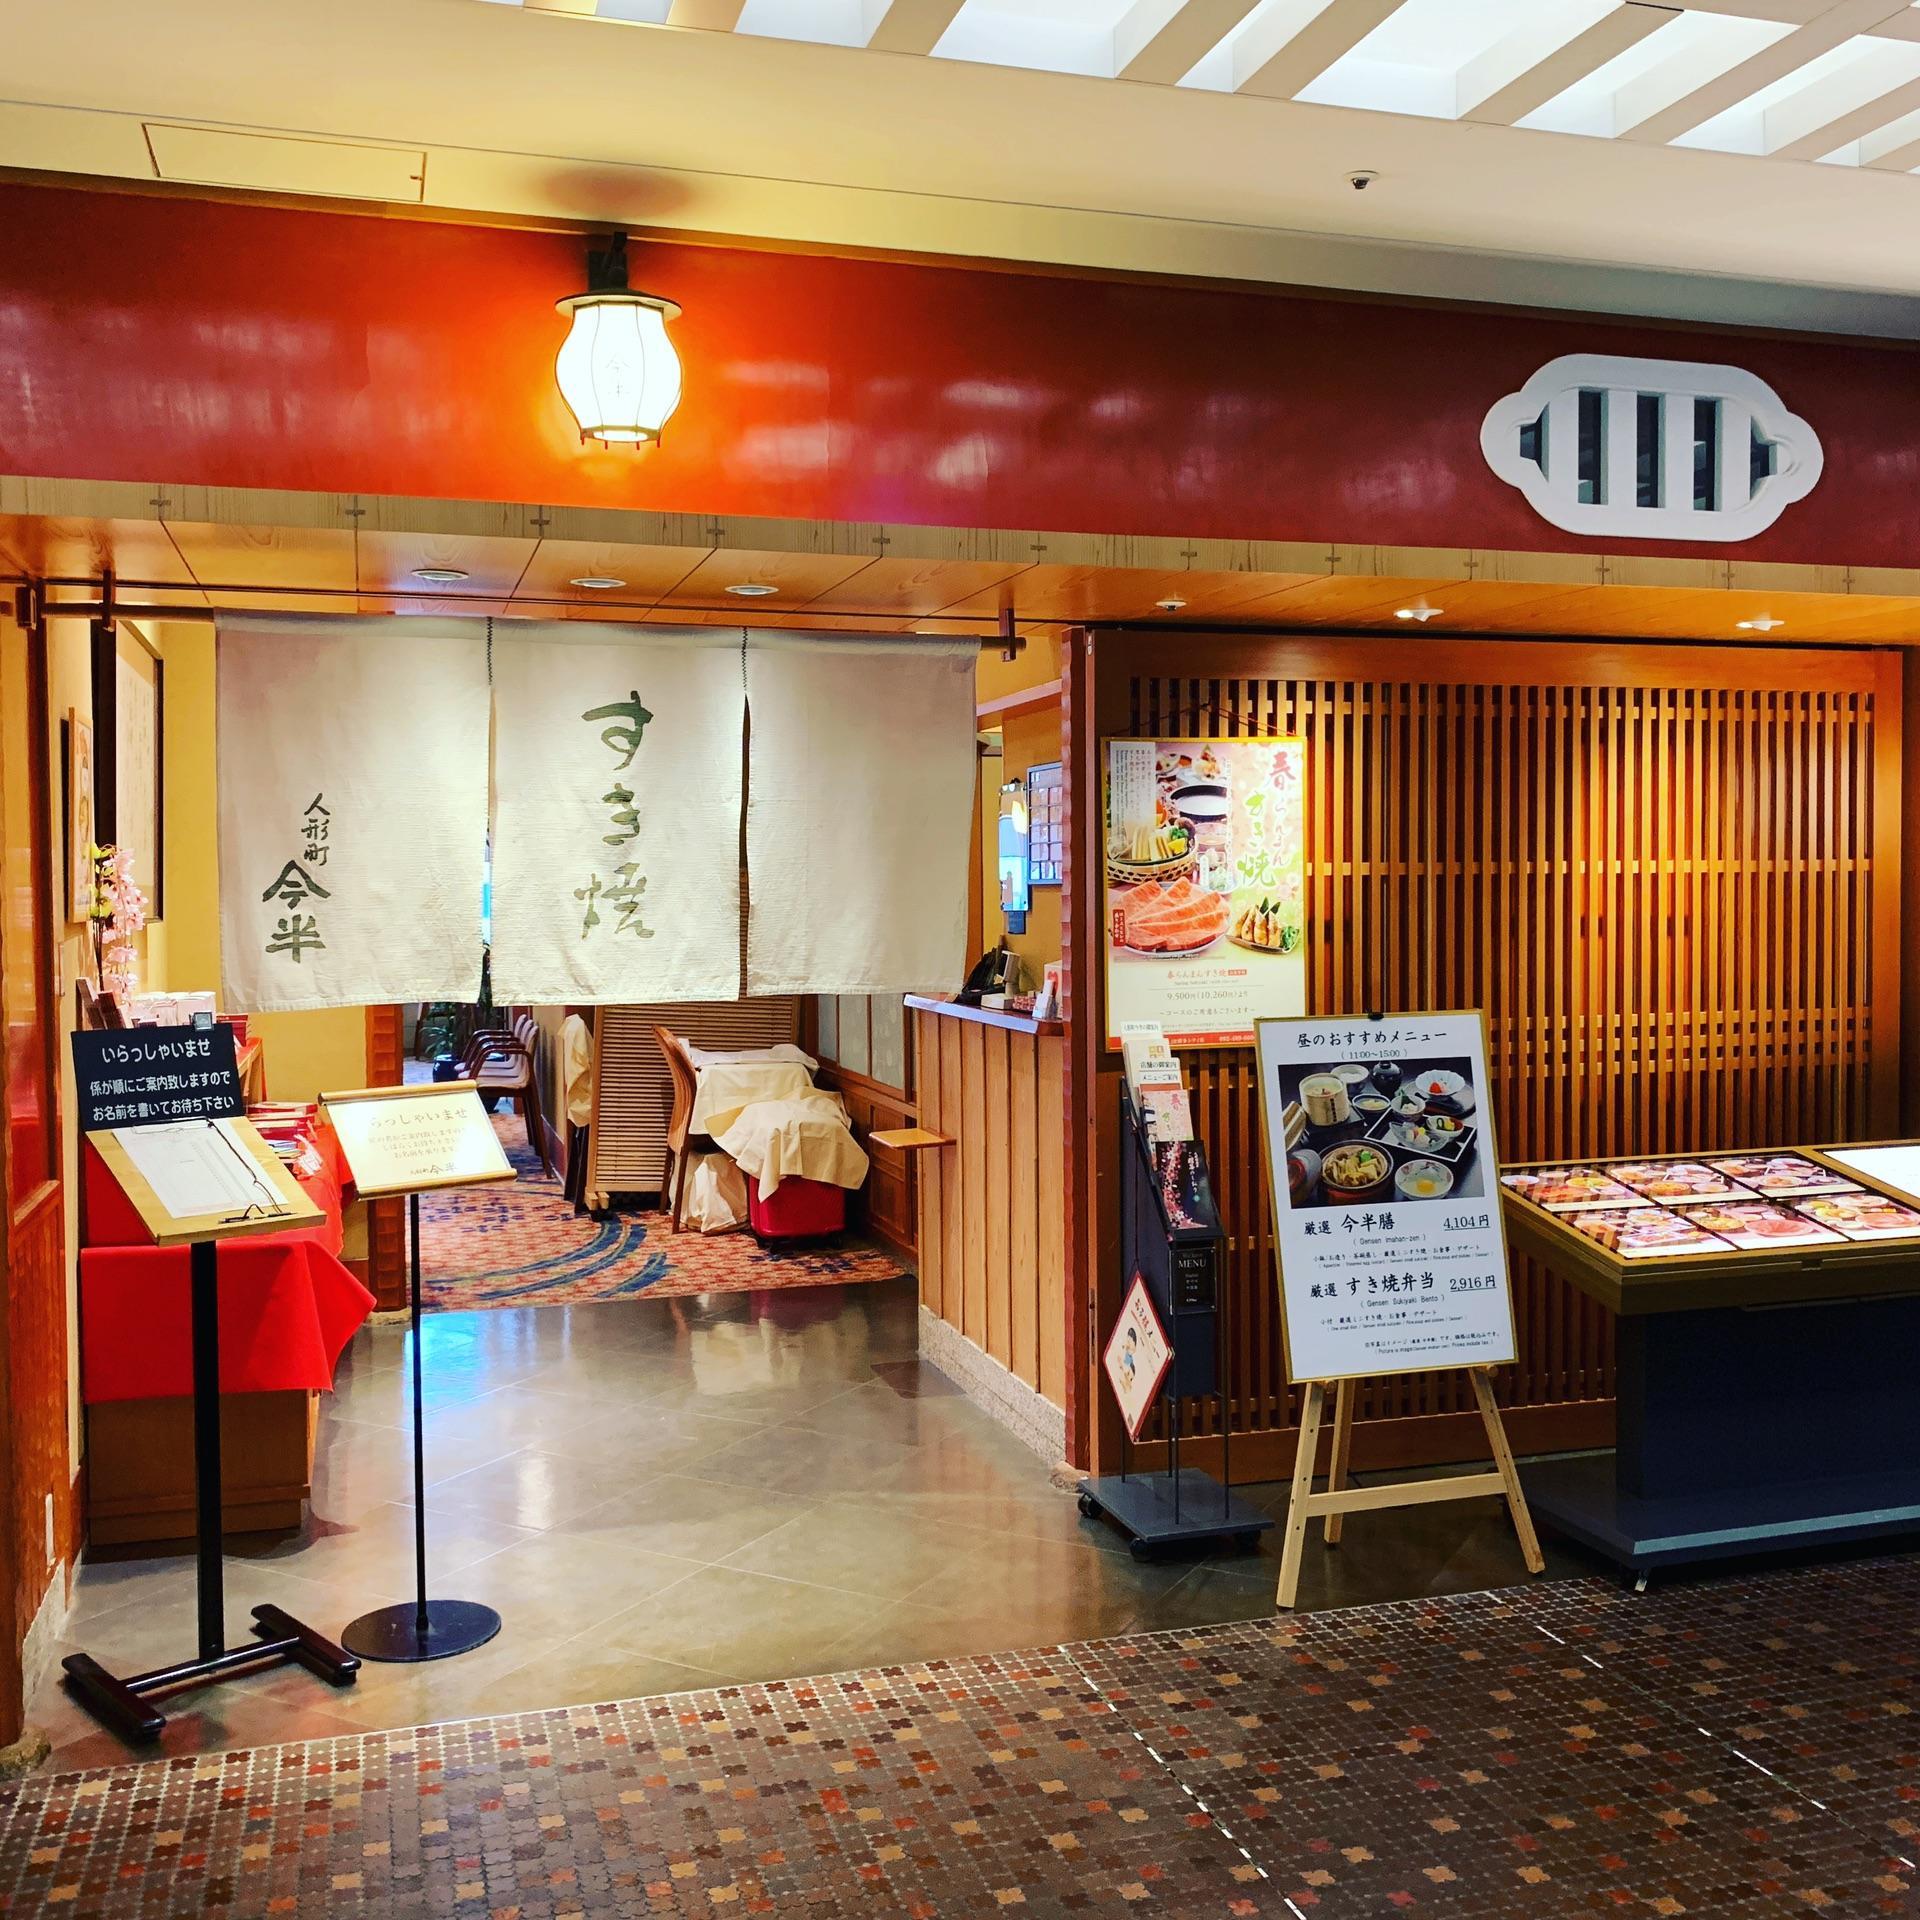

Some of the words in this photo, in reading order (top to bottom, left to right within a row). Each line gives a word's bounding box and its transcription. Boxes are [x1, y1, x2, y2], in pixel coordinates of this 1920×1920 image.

[573, 690, 655, 941] すき焼
[302, 792, 330, 867] 人形町
[262, 859, 332, 963] 今半
[102, 1038, 211, 1063] いらっしゃいませ
[1297, 1031, 1448, 1048] 昼のおすすめメニュー
[90, 1070, 231, 1097] 係が順にご案内致しますので
[93, 1095, 234, 1121] お名前を書いてお待ち下さい
[1304, 1220, 1332, 1236] 厳選
[1341, 1211, 1395, 1234] 今半膳
[1178, 1258, 1207, 1268] MENU
[1310, 1282, 1338, 1298] 厳選
[1346, 1271, 1434, 1296] すき焼弁当
